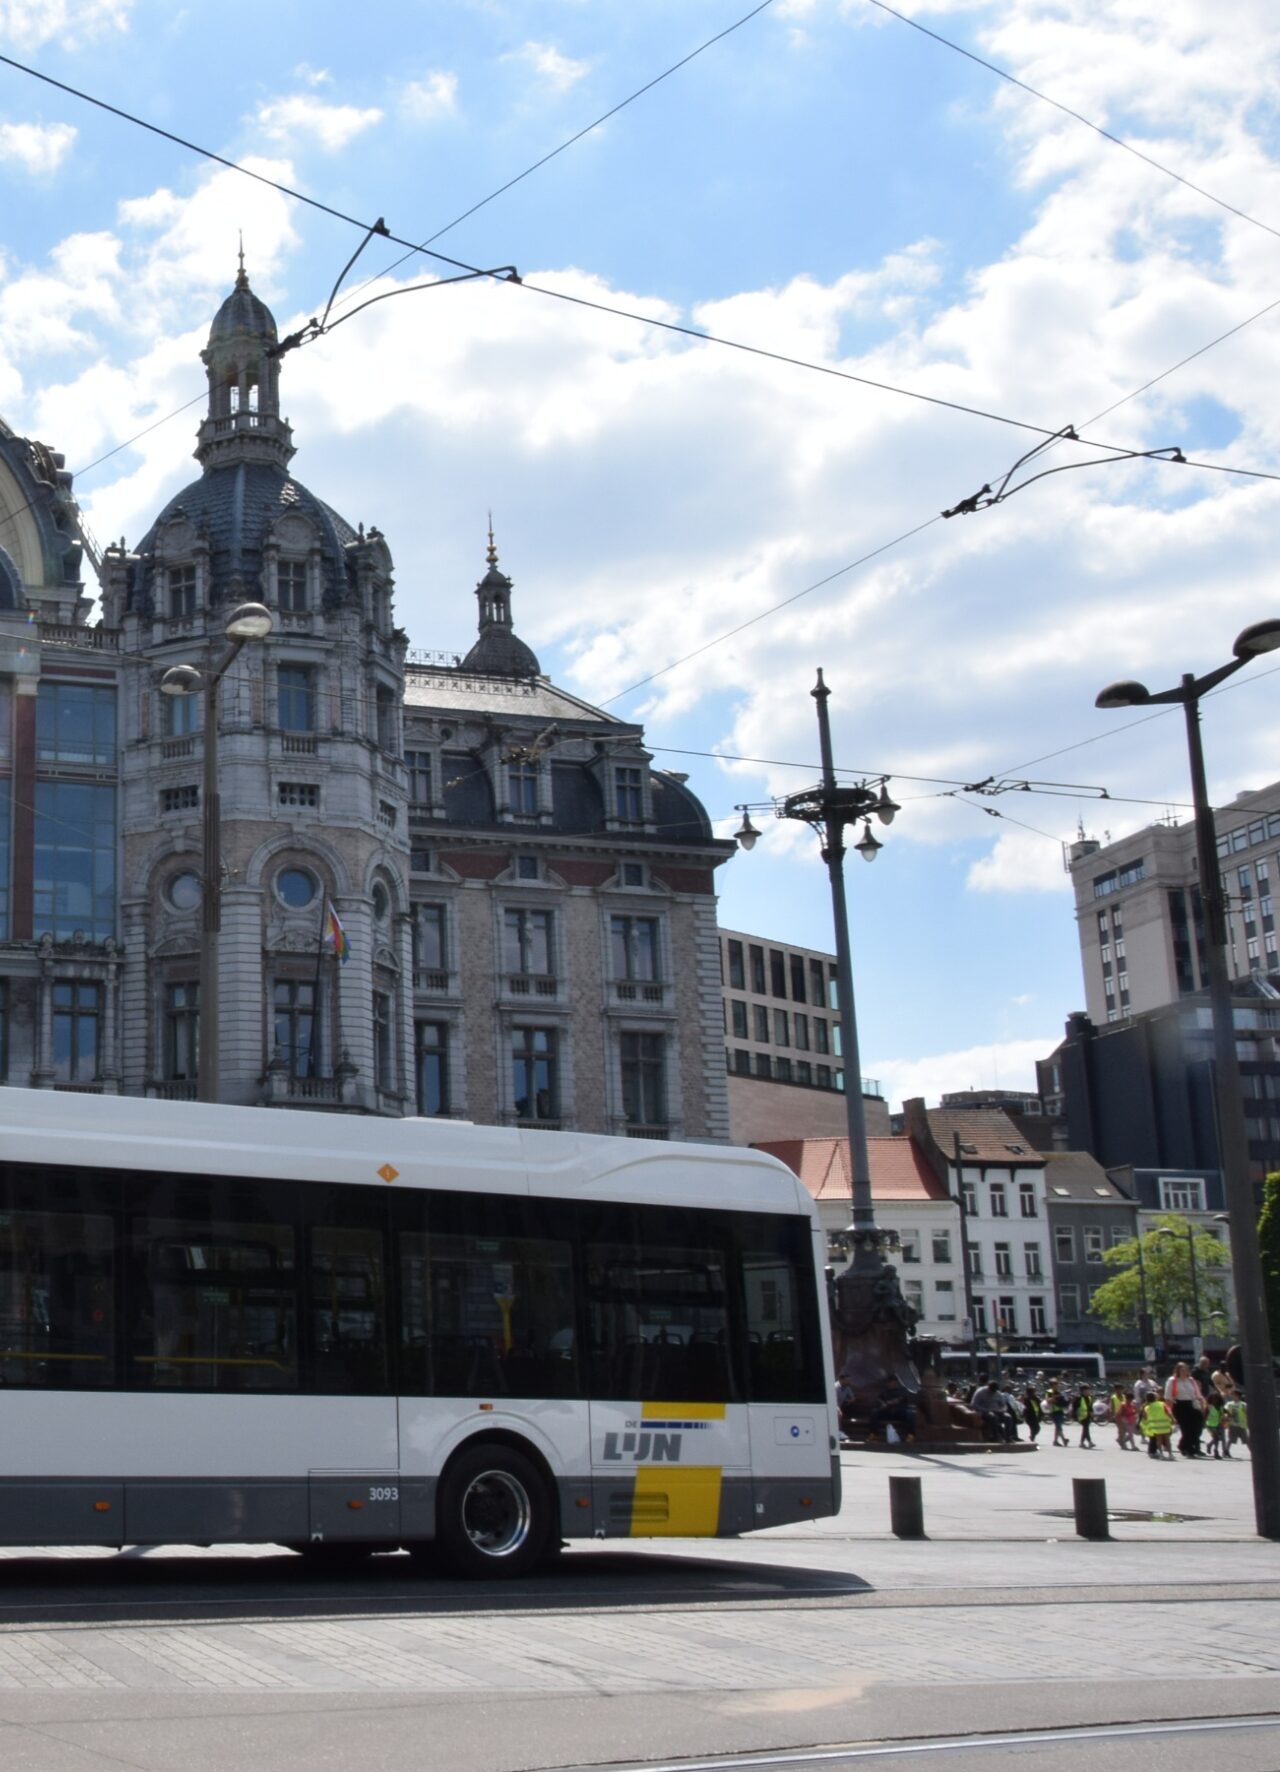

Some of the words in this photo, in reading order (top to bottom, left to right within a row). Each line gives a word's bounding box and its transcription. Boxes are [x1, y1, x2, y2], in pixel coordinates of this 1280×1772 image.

[624, 1419, 638, 1429] DE
[602, 1431, 683, 1462] LIJN
[368, 1487, 399, 1501] 3093
